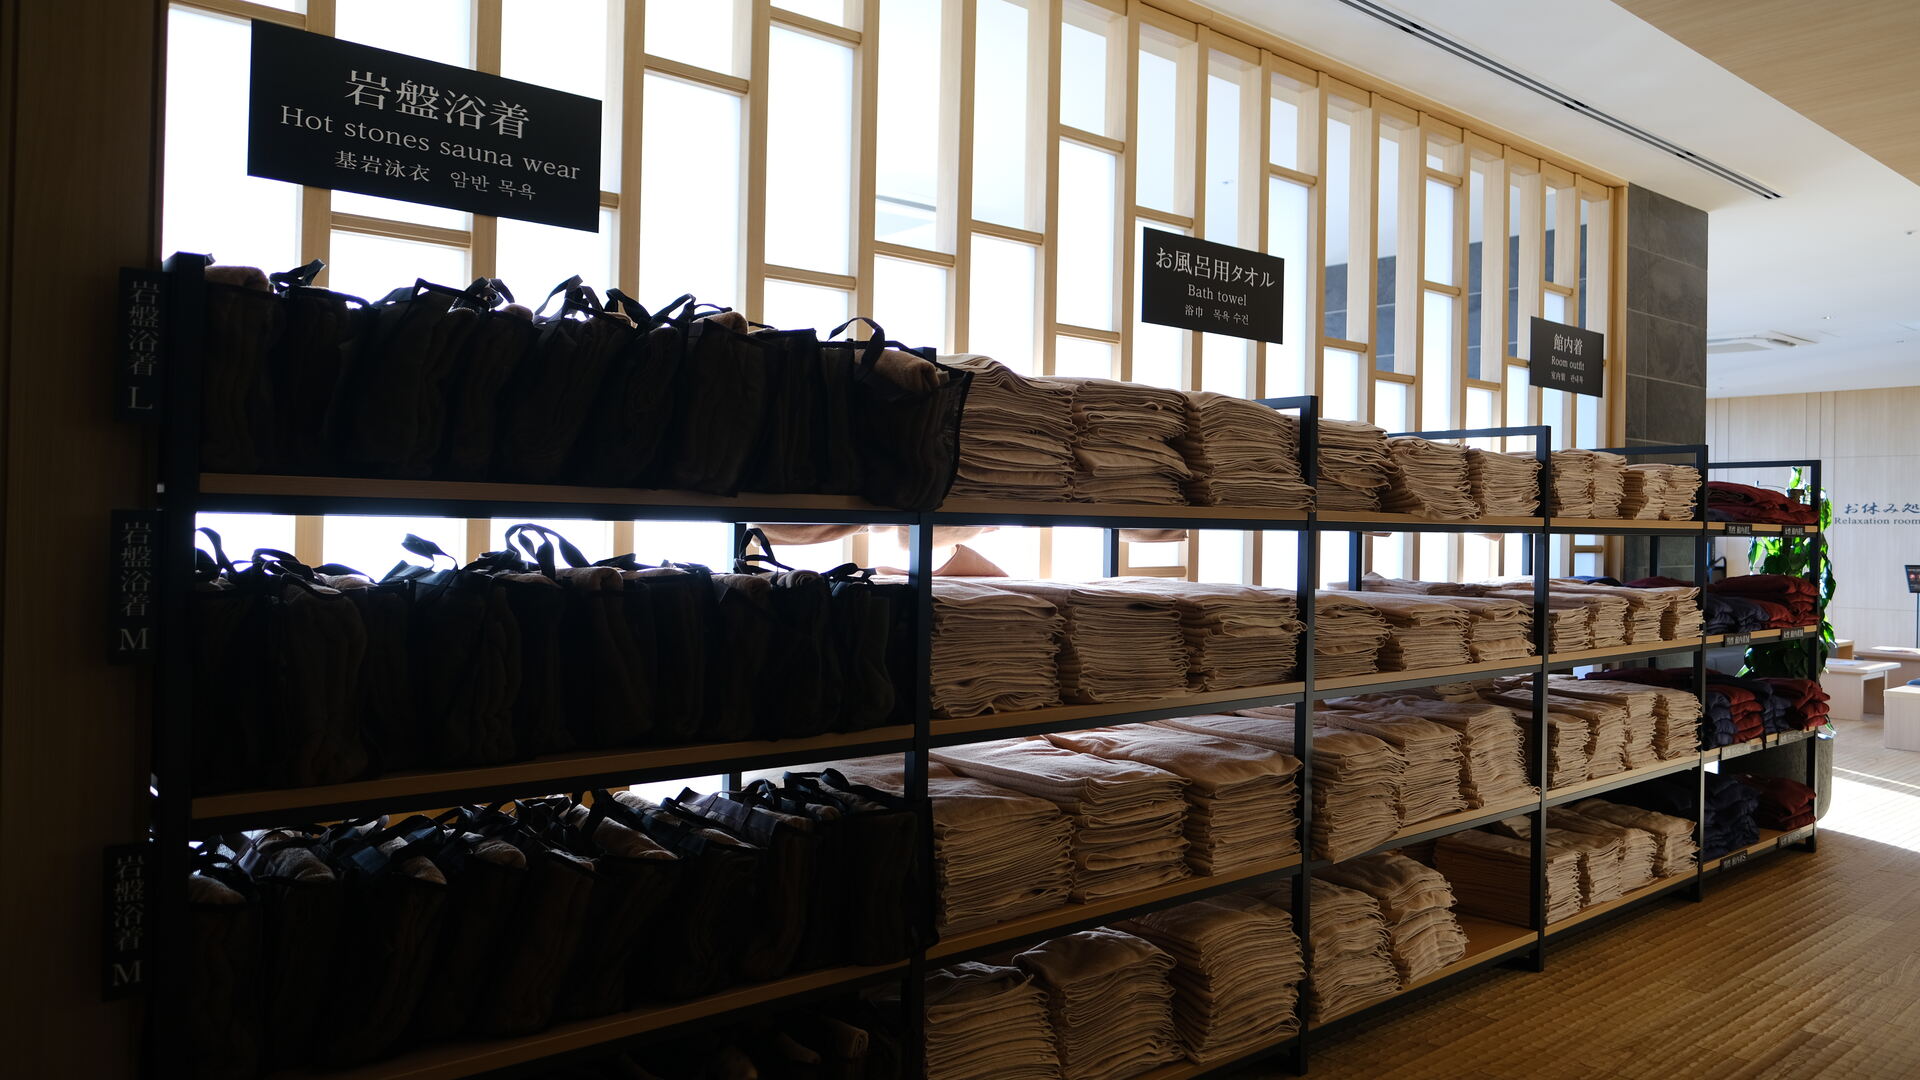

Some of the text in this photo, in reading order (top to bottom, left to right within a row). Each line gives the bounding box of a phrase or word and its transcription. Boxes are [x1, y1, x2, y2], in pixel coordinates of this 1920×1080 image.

[344, 69, 530, 139] 岩盤浴着
[280, 105, 581, 180] Hot stones sauna wear
[335, 150, 430, 182] 基岩泳衣
[450, 171, 537, 201] 암반 목욕
[1155, 247, 1275, 287] お風呂用タオル
[1188, 283, 1247, 306] Bath towel
[1184, 304, 1203, 318] 浴巾
[128, 280, 160, 410] 岩盤浴着 L
[1553, 333, 1583, 356] 館内着
[1551, 355, 1568, 368] Room
[1834, 516, 1890, 525] Relaxation
[1843, 501, 1920, 515] お休み処
[119, 521, 152, 651] 岩盤浴着 M
[112, 960, 144, 987] M
